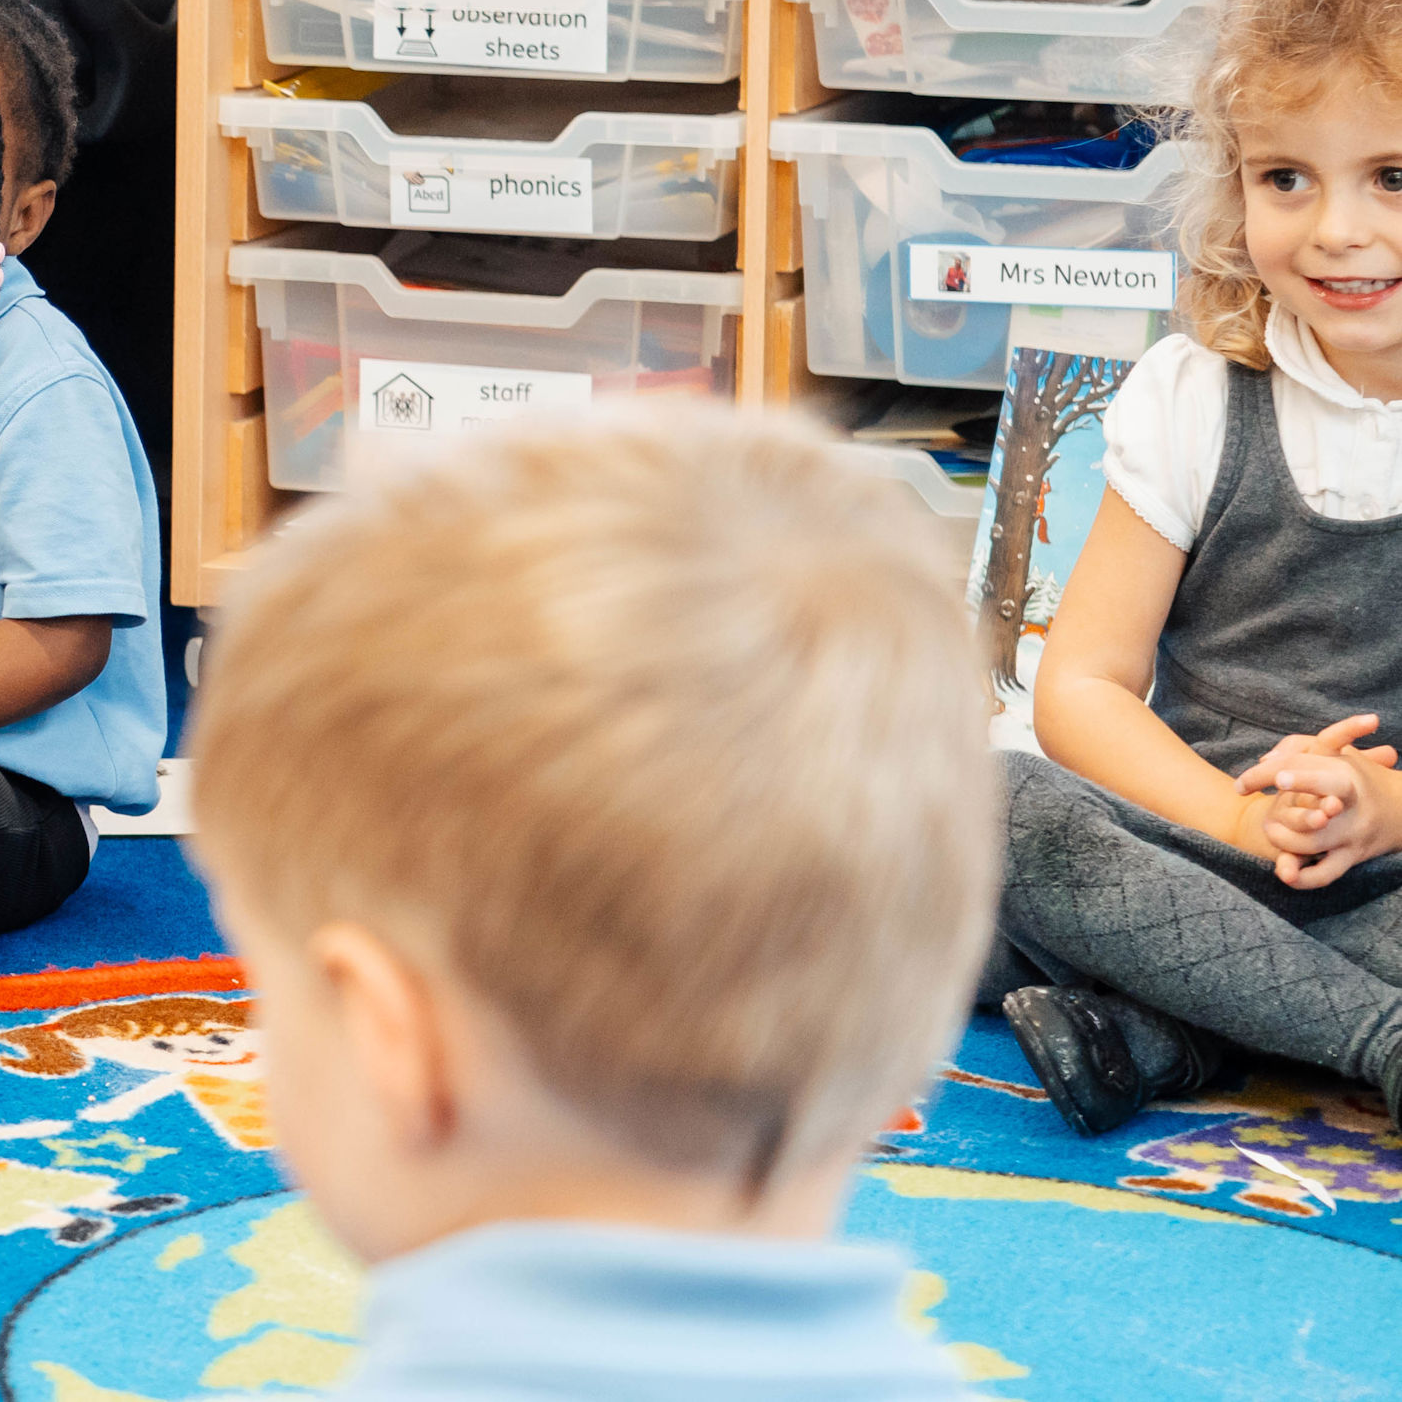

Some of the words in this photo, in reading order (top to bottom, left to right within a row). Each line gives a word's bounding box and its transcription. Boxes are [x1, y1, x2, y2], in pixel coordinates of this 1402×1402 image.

[485, 36, 561, 61] sheets
[489, 173, 582, 203] phonics
[1000, 261, 1044, 286] Mrs
[1054, 264, 1157, 290] Newton
[479, 381, 533, 403] staff
